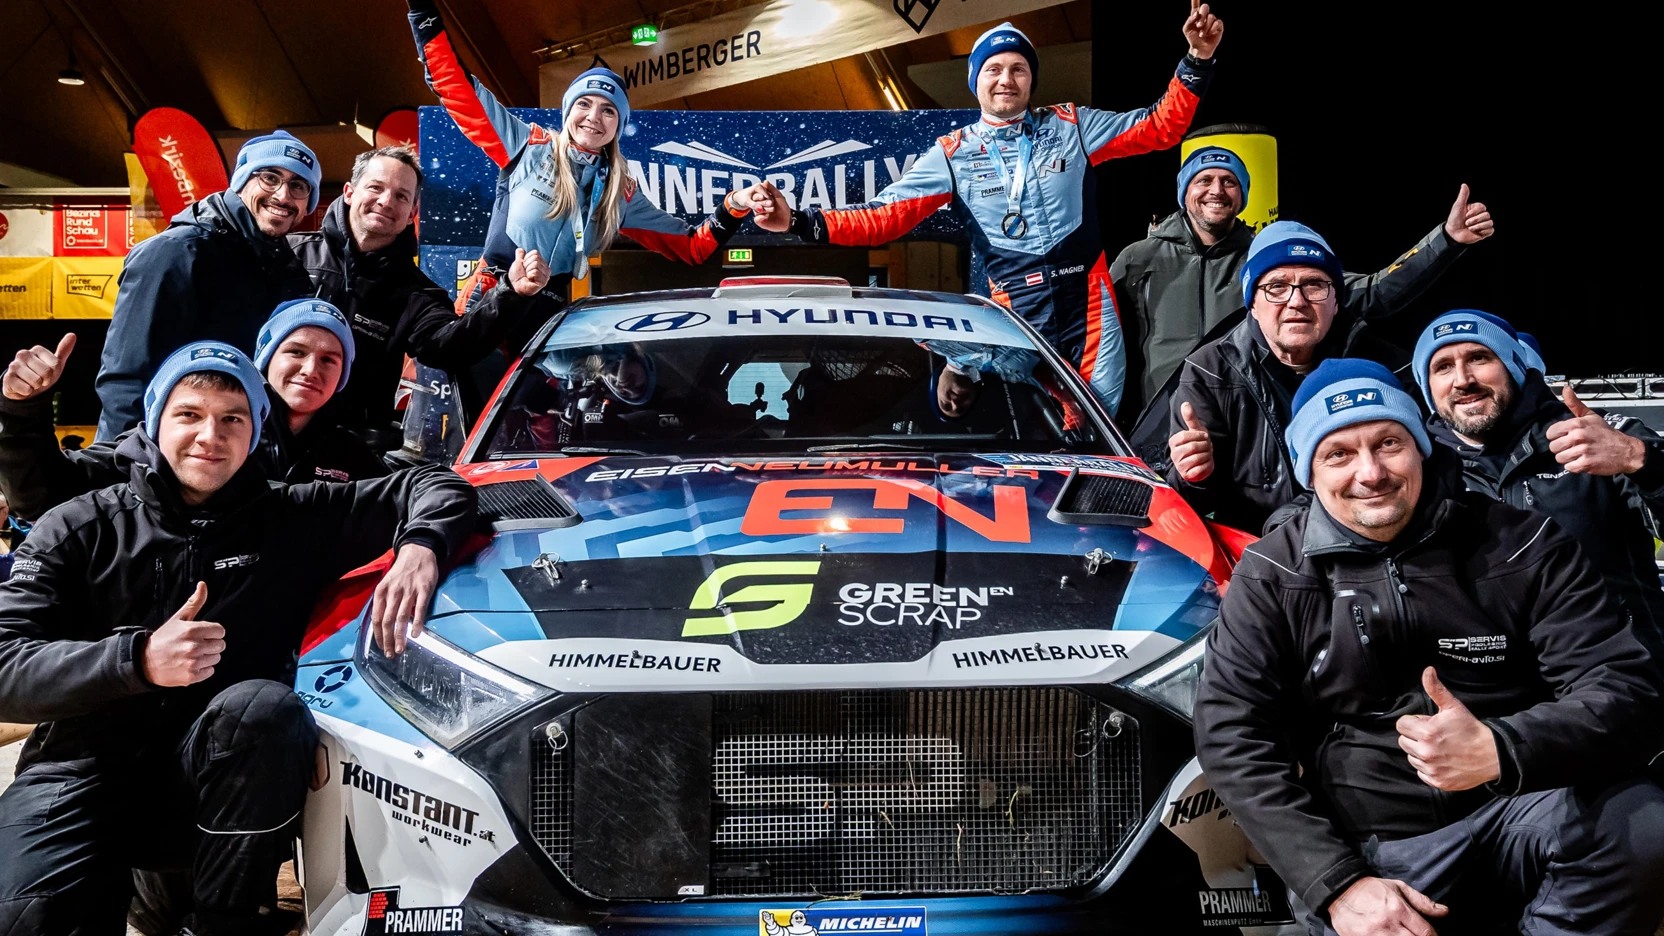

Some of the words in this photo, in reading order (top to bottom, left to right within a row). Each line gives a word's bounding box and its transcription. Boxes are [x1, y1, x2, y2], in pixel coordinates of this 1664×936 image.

[623, 30, 762, 90] WIMBERGER
[66, 217, 93, 226] Rund
[66, 226, 99, 235] Schau
[69, 276, 92, 285] inter
[1050, 270, 1059, 278] S.
[1058, 264, 1085, 276] WAGNER
[71, 284, 102, 292] wetten
[727, 308, 974, 333] HYUNDAI
[838, 583, 989, 607] GREEN
[837, 602, 982, 629] SCRAP
[1469, 635, 1507, 643] SERVIS
[548, 653, 721, 673] HIMMELBAUER
[952, 643, 1130, 669] HIMMELBAUER
[391, 809, 472, 847] workwear
[1199, 890, 1272, 914] PRAMMER
[384, 908, 464, 934] PRAMMER
[818, 916, 923, 930] MICHELIN
[1203, 918, 1248, 927] MASCHINENPUTZ
